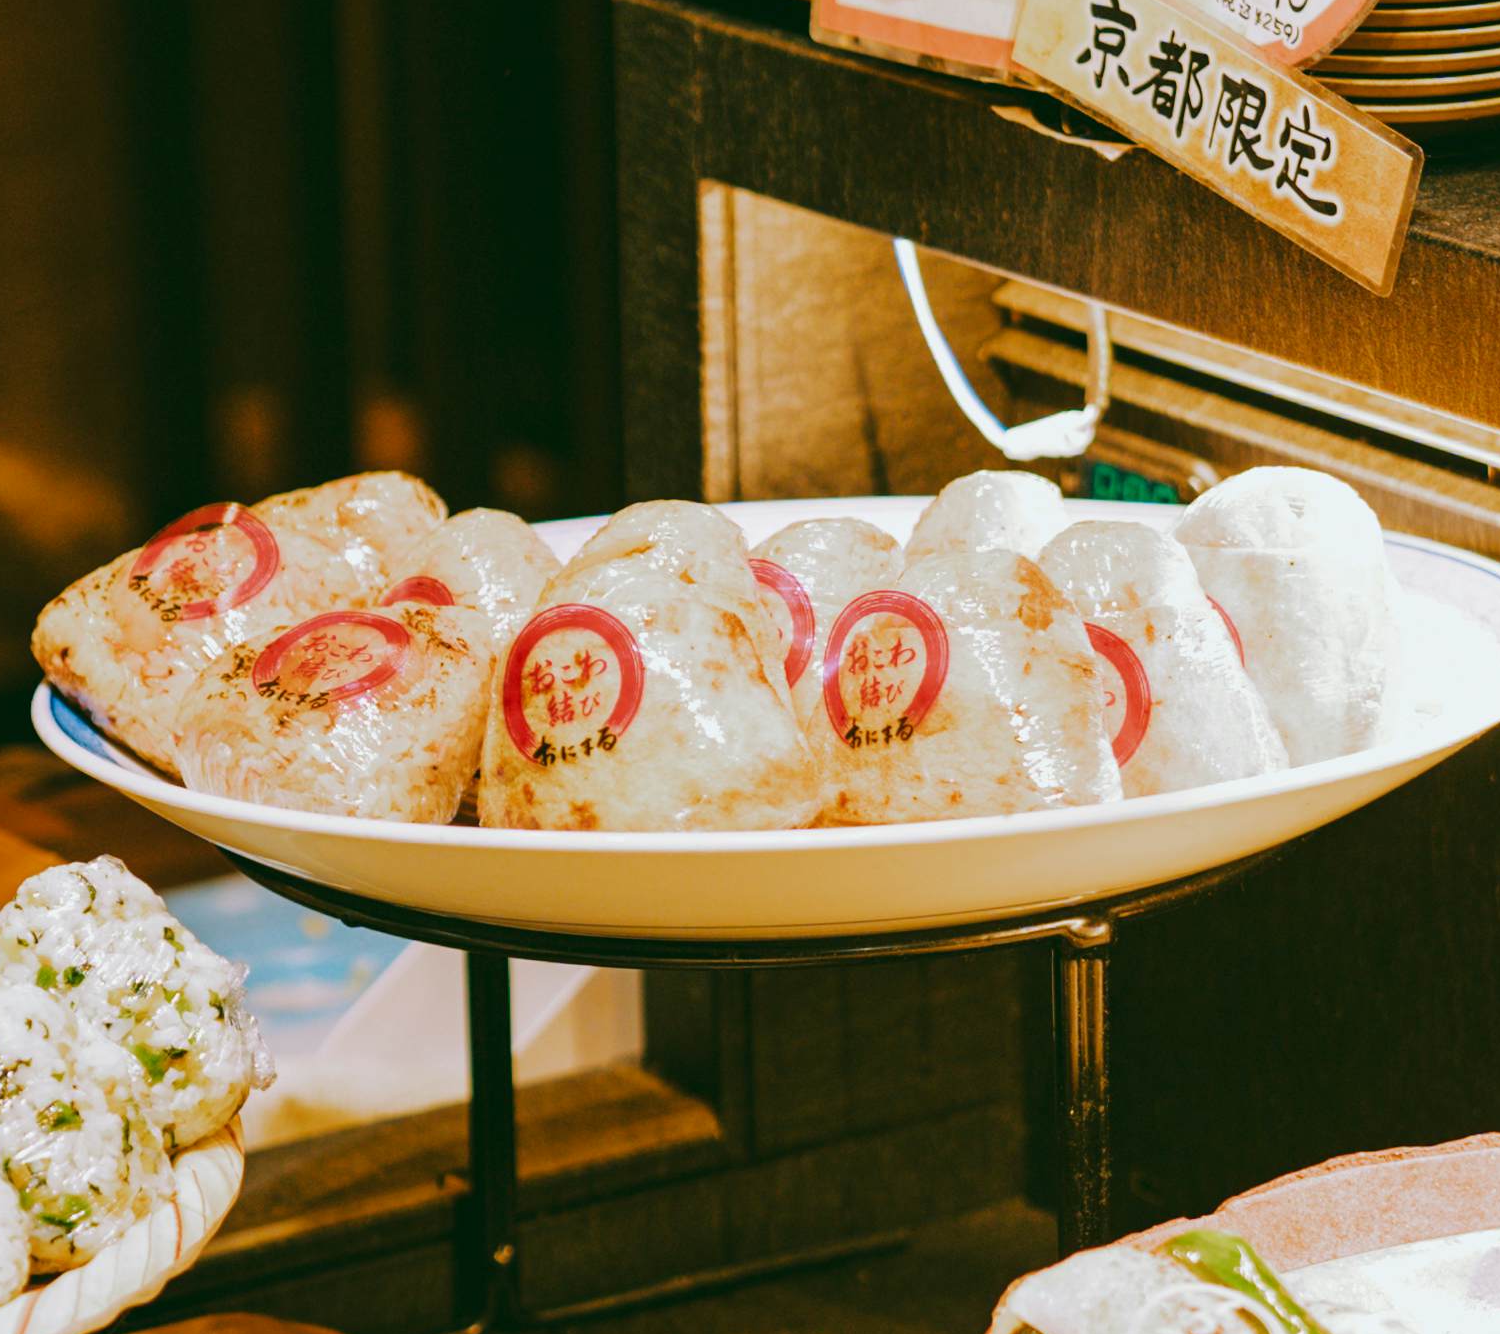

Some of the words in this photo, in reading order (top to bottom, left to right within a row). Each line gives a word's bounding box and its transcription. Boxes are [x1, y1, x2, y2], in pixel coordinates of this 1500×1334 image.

[527, 649, 608, 696] おこわ
[846, 638, 918, 676] おこわ
[258, 677, 330, 709] おにまる
[546, 689, 602, 728] 結び
[859, 678, 906, 710] 結び
[532, 726, 619, 768] おにまる
[844, 714, 915, 749] おにまる
